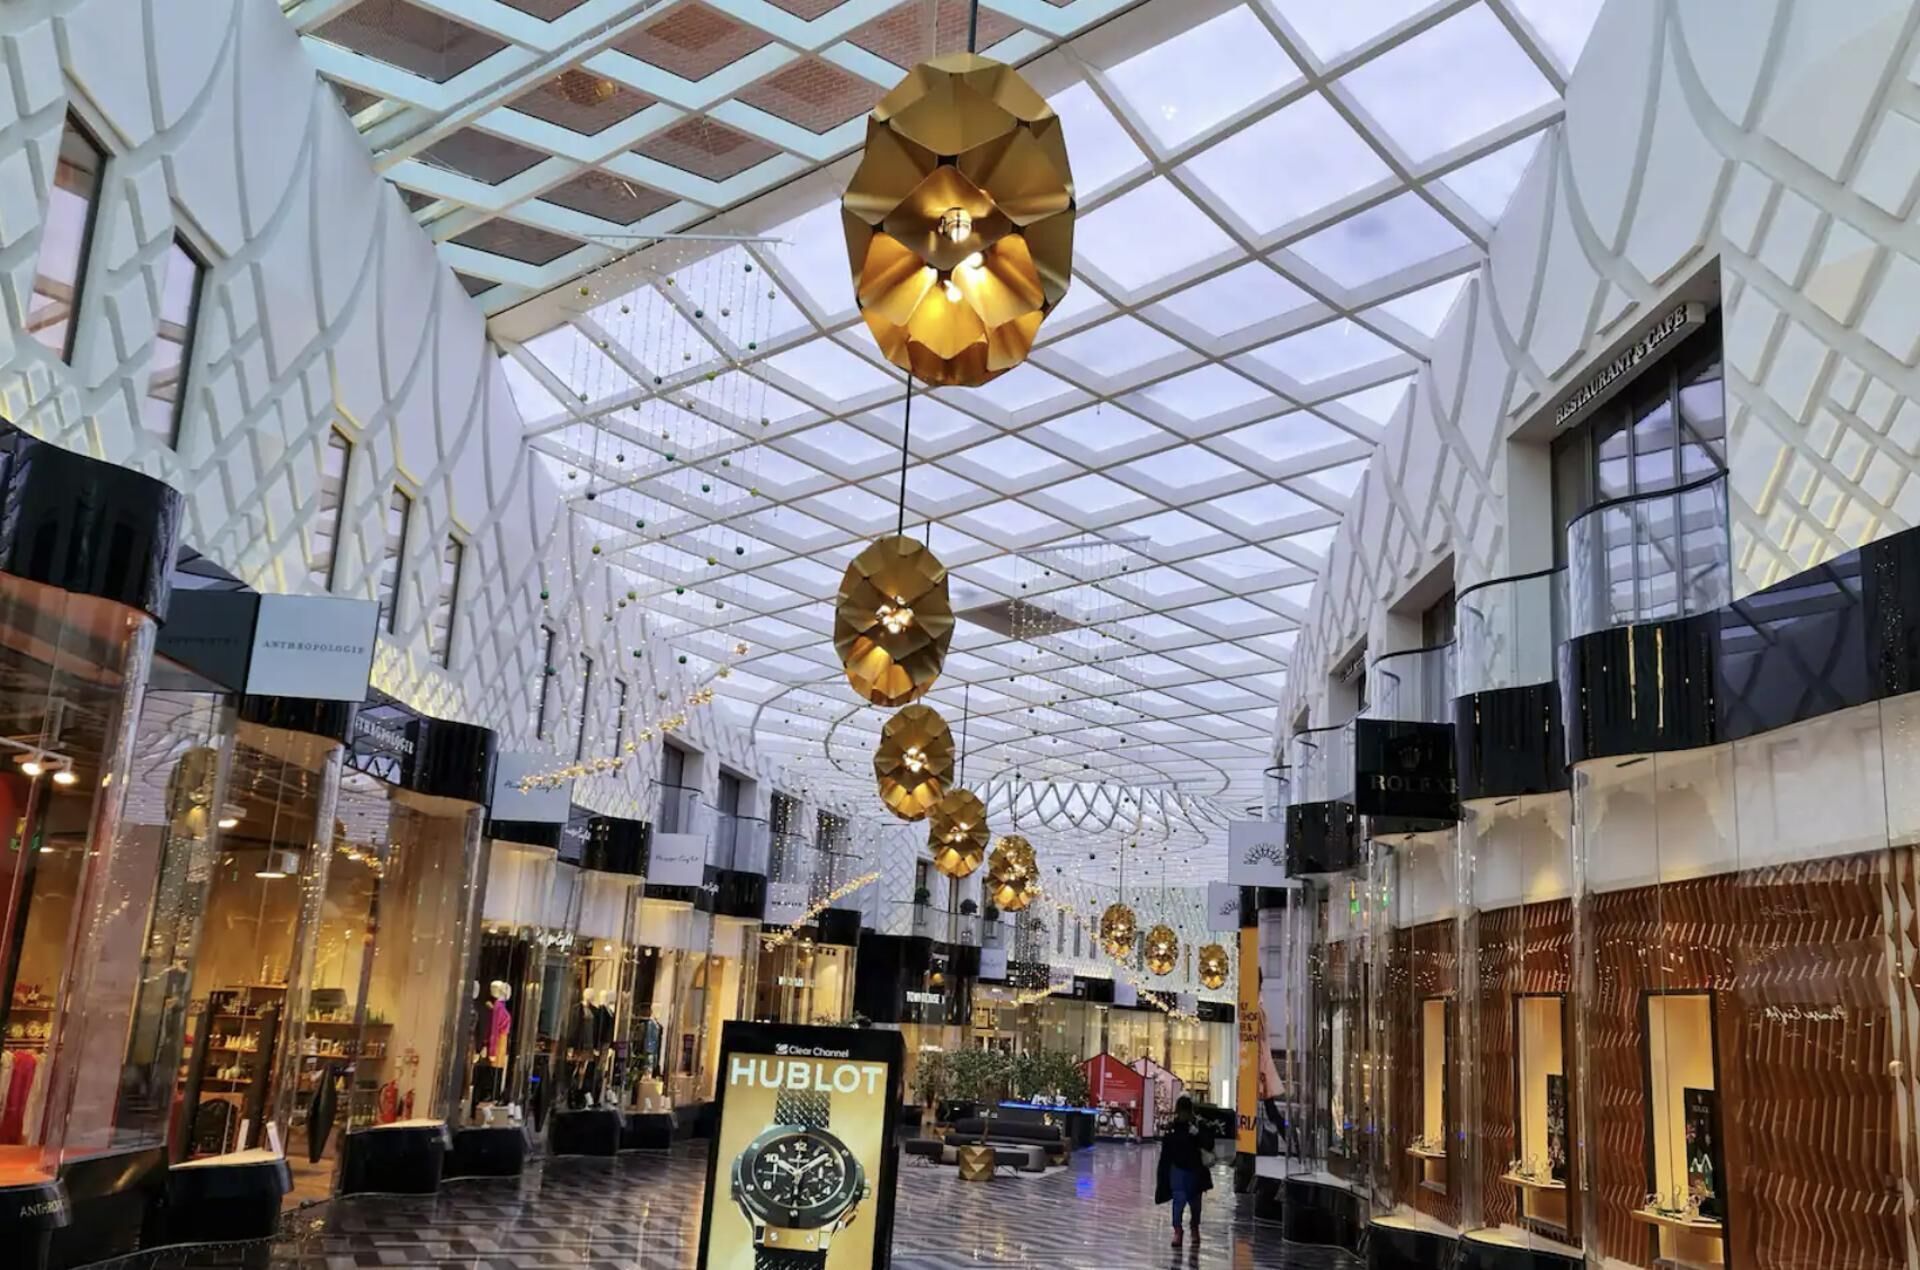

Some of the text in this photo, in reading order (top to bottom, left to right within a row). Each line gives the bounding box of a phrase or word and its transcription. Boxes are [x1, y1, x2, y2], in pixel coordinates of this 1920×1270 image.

[1555, 348, 1634, 426] RESTAURANT
[263, 640, 364, 654] ANTHROPOLOGIE
[1369, 775, 1451, 794] ROLEX
[788, 1045, 849, 1058] Clear Channel
[730, 1057, 883, 1095] HUBLOT
[793, 1141, 807, 1152] 12
[764, 1152, 779, 1164] 10
[763, 1180, 772, 1190] 8
